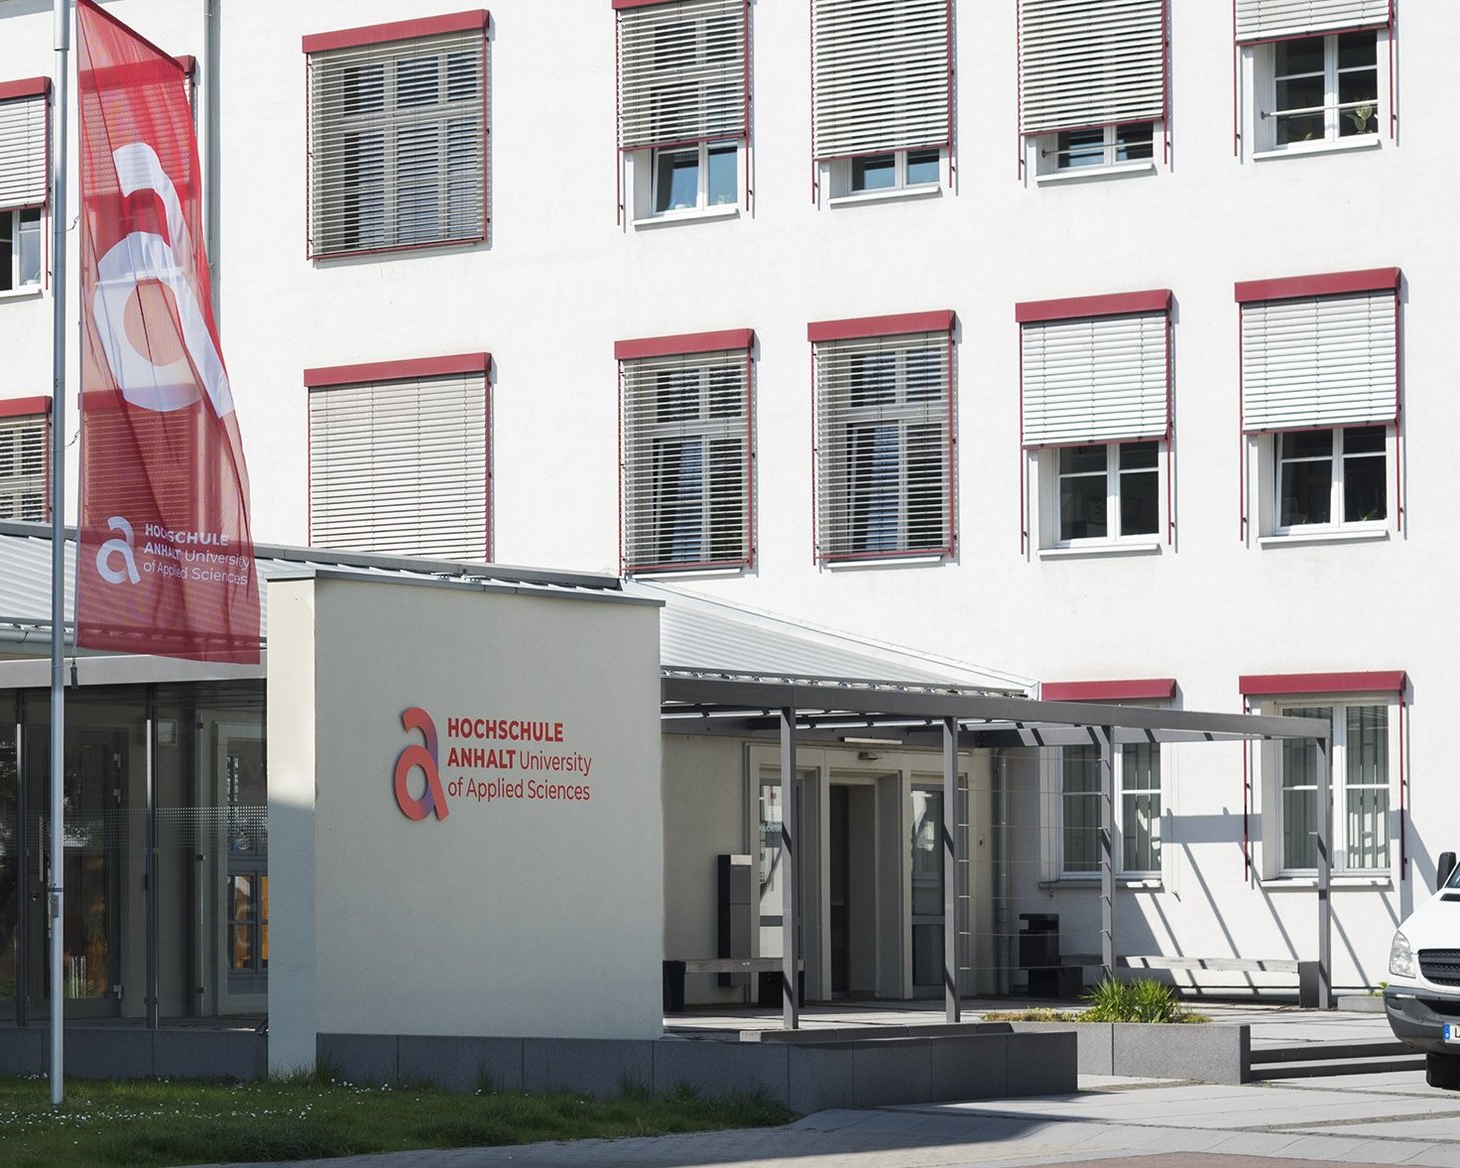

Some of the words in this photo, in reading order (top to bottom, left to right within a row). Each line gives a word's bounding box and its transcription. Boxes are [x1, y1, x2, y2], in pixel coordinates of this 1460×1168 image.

[145, 523, 230, 547] HOCSCHULE
[143, 560, 156, 573] of
[191, 567, 248, 585] Sciences
[184, 549, 250, 571] University
[447, 717, 564, 742] HOCHSCHULE
[447, 747, 516, 769] ANHALT
[519, 750, 592, 776] University
[447, 776, 464, 797] of
[466, 777, 524, 802] Applied
[527, 779, 590, 800] Sciences
